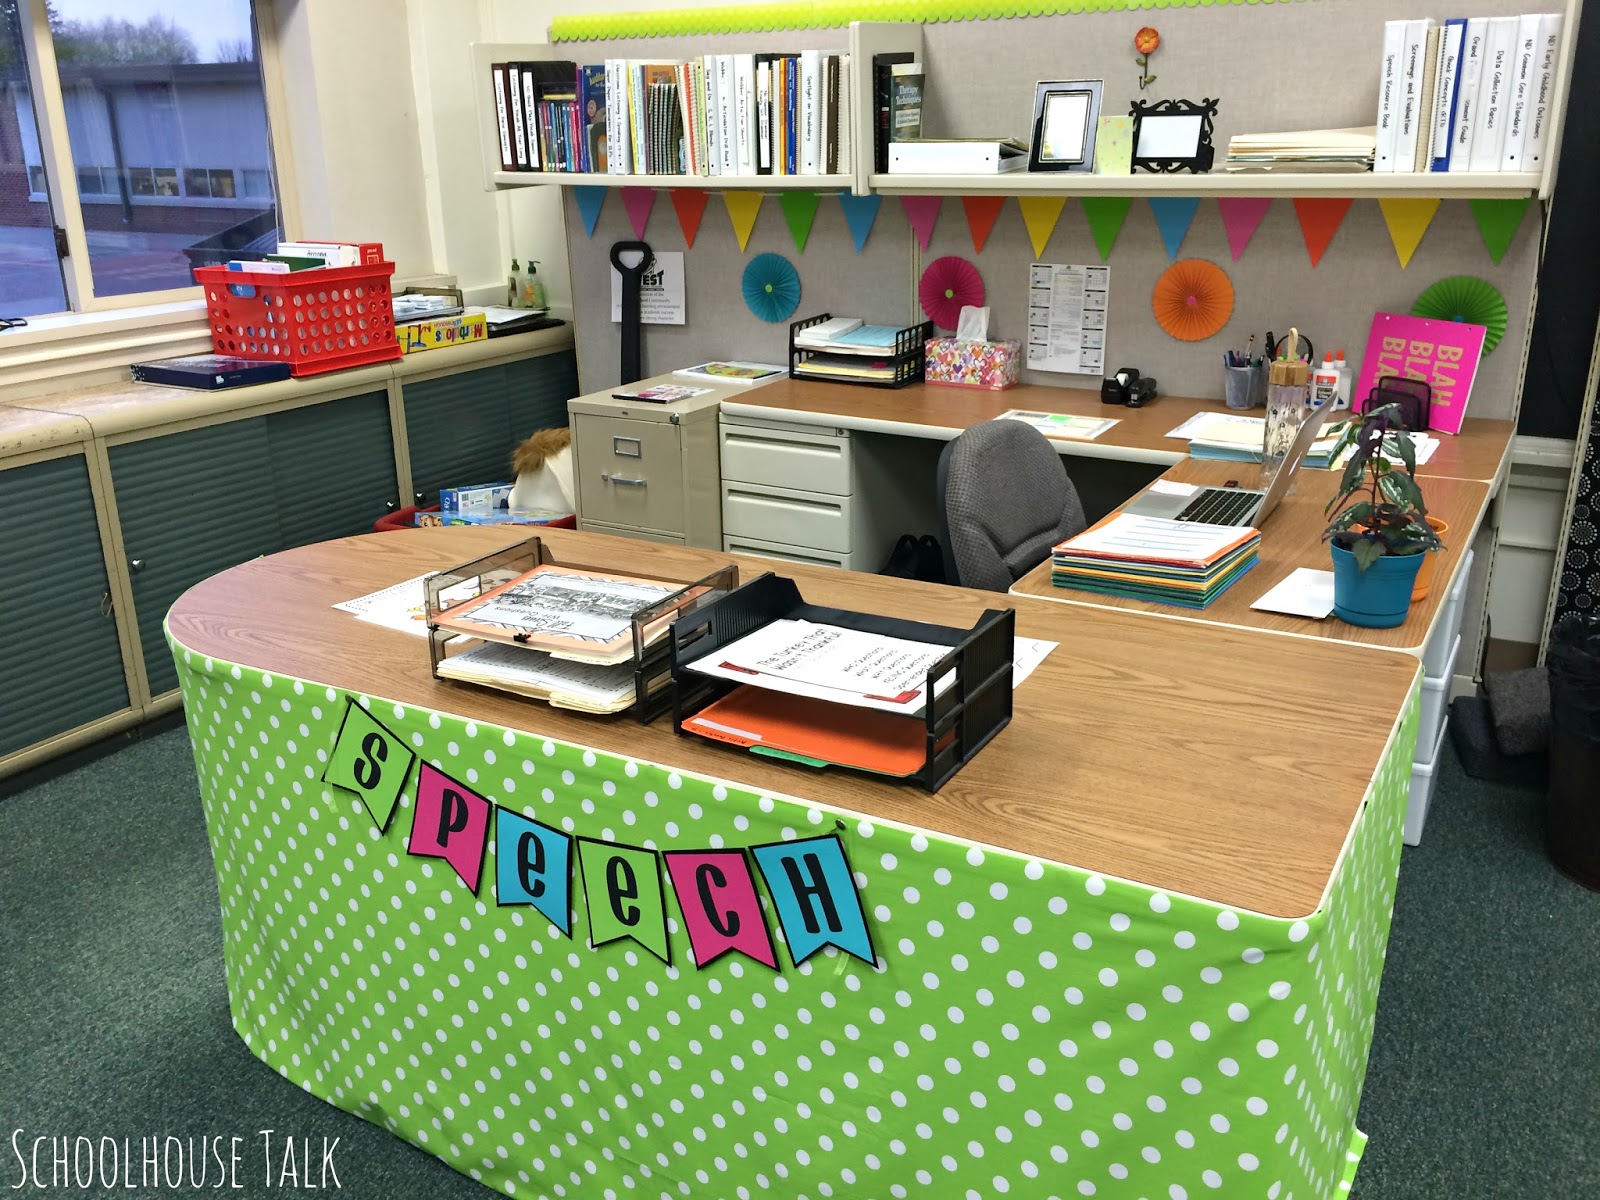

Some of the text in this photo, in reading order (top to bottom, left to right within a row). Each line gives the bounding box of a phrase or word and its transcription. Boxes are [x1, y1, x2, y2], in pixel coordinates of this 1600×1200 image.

[1470, 36, 1480, 57] Grand
[1541, 50, 1554, 69] Early
[1386, 54, 1395, 78] Speech
[1520, 53, 1531, 79] Common
[899, 86, 919, 94] Therapy
[1384, 80, 1392, 110] Resource
[1441, 77, 1453, 107] Concepts
[1487, 50, 1504, 129] Data Collection Basics
[1518, 82, 1526, 98] Core
[1538, 72, 1550, 104] Childhood
[1404, 97, 1413, 135] Evaluations
[1512, 102, 1523, 137] Standards
[1534, 107, 1545, 139] Outcomes
[642, 269, 664, 286] EST
[1373, 337, 1406, 384] BLA
[1431, 345, 1464, 406] BLAH
[494, 606, 539, 617] Questions
[756, 628, 828, 666] The Turkey That
[771, 653, 807, 670] Wasn't
[800, 631, 842, 653] Thankful
[854, 647, 884, 663] Questions
[869, 650, 898, 666] Questions
[883, 653, 912, 670] Questions
[902, 654, 930, 670] Questions
